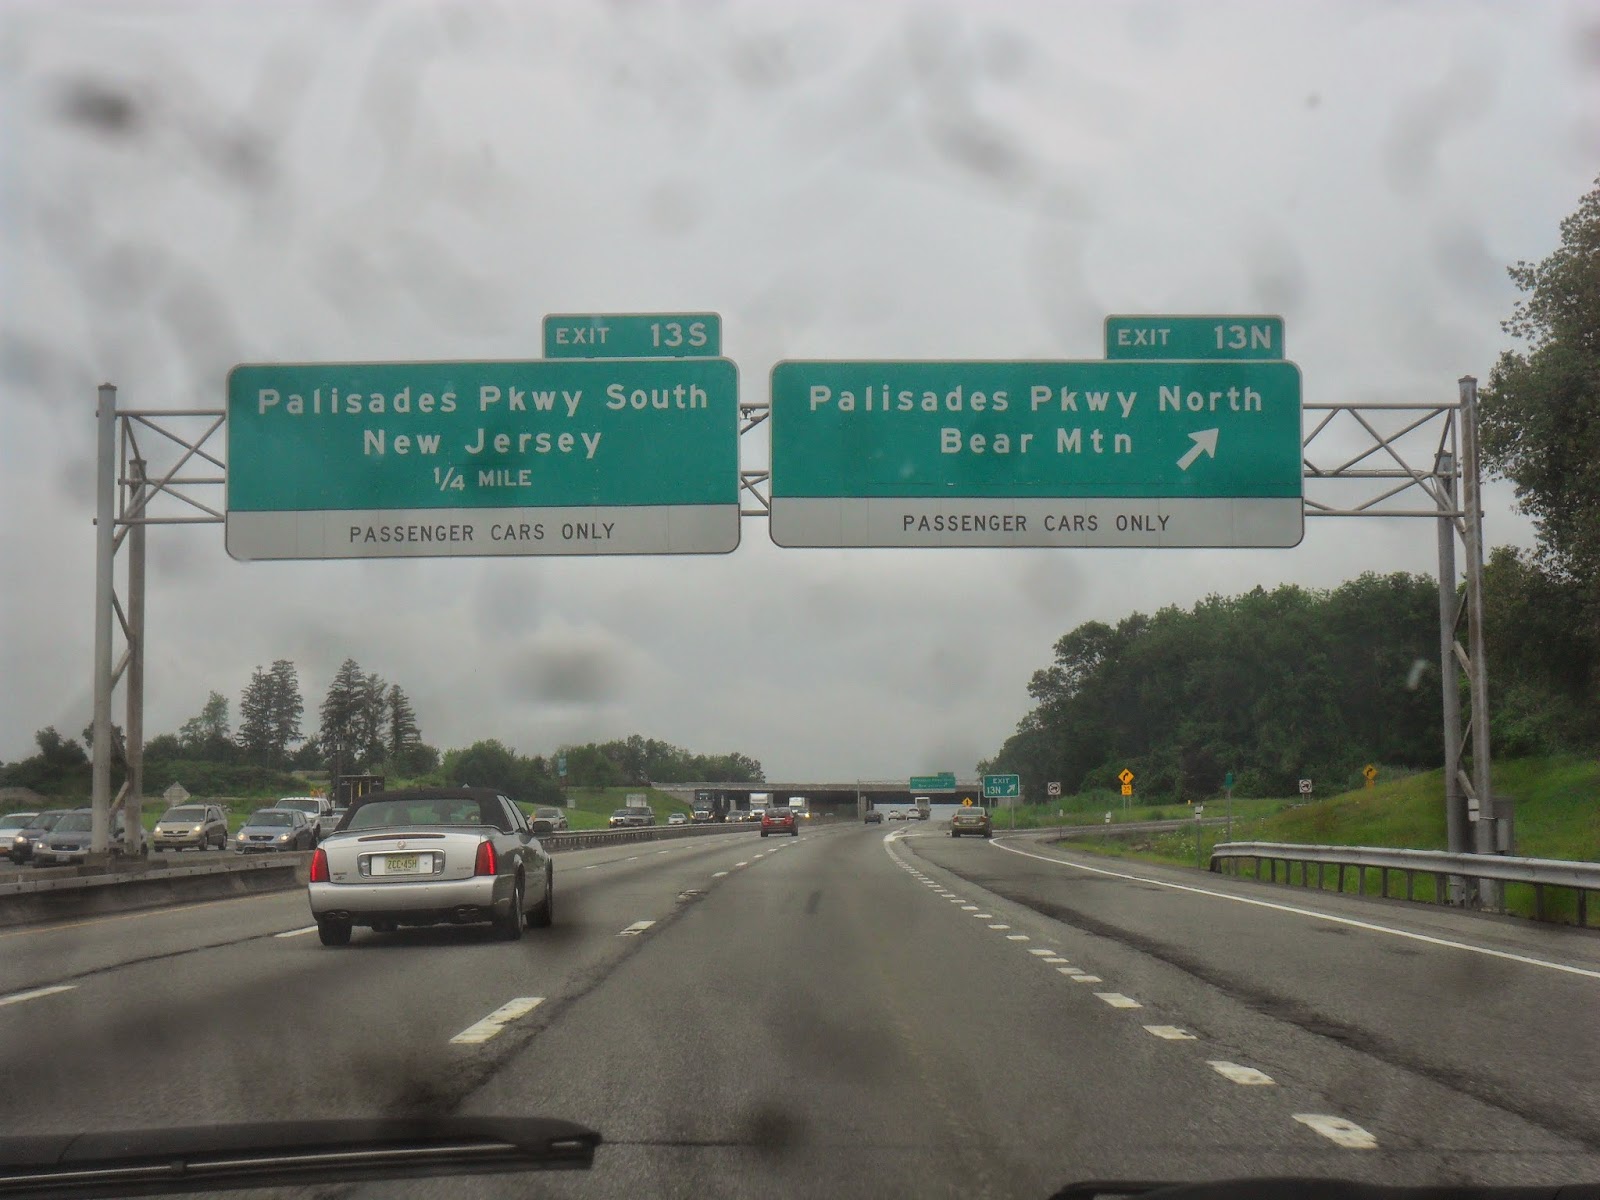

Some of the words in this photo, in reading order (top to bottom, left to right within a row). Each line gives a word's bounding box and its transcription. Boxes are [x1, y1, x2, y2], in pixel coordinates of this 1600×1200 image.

[555, 327, 610, 346] EXIT
[650, 322, 707, 349] 13S
[1117, 329, 1169, 347] EXIT
[1214, 324, 1271, 350] 13N
[257, 386, 458, 416] Palisades
[479, 385, 583, 418] Pkwy
[605, 383, 708, 411] South
[808, 384, 1010, 413] Palisades
[1030, 384, 1138, 419] Pkwy
[1158, 385, 1263, 414] North
[363, 428, 442, 456] New
[464, 427, 603, 461] Jersey
[940, 427, 1034, 455] Bear
[1056, 427, 1134, 455] Mtn
[478, 468, 533, 487] MILE
[349, 524, 475, 544] PASSENGER
[490, 523, 546, 542] CARS
[561, 522, 616, 541] ONLY
[902, 514, 1028, 533] PASSENGER
[1043, 514, 1099, 533] CARS
[1114, 514, 1171, 533] ONLY
[986, 786, 1001, 794] 13N
[992, 777, 1010, 785] EXIT
